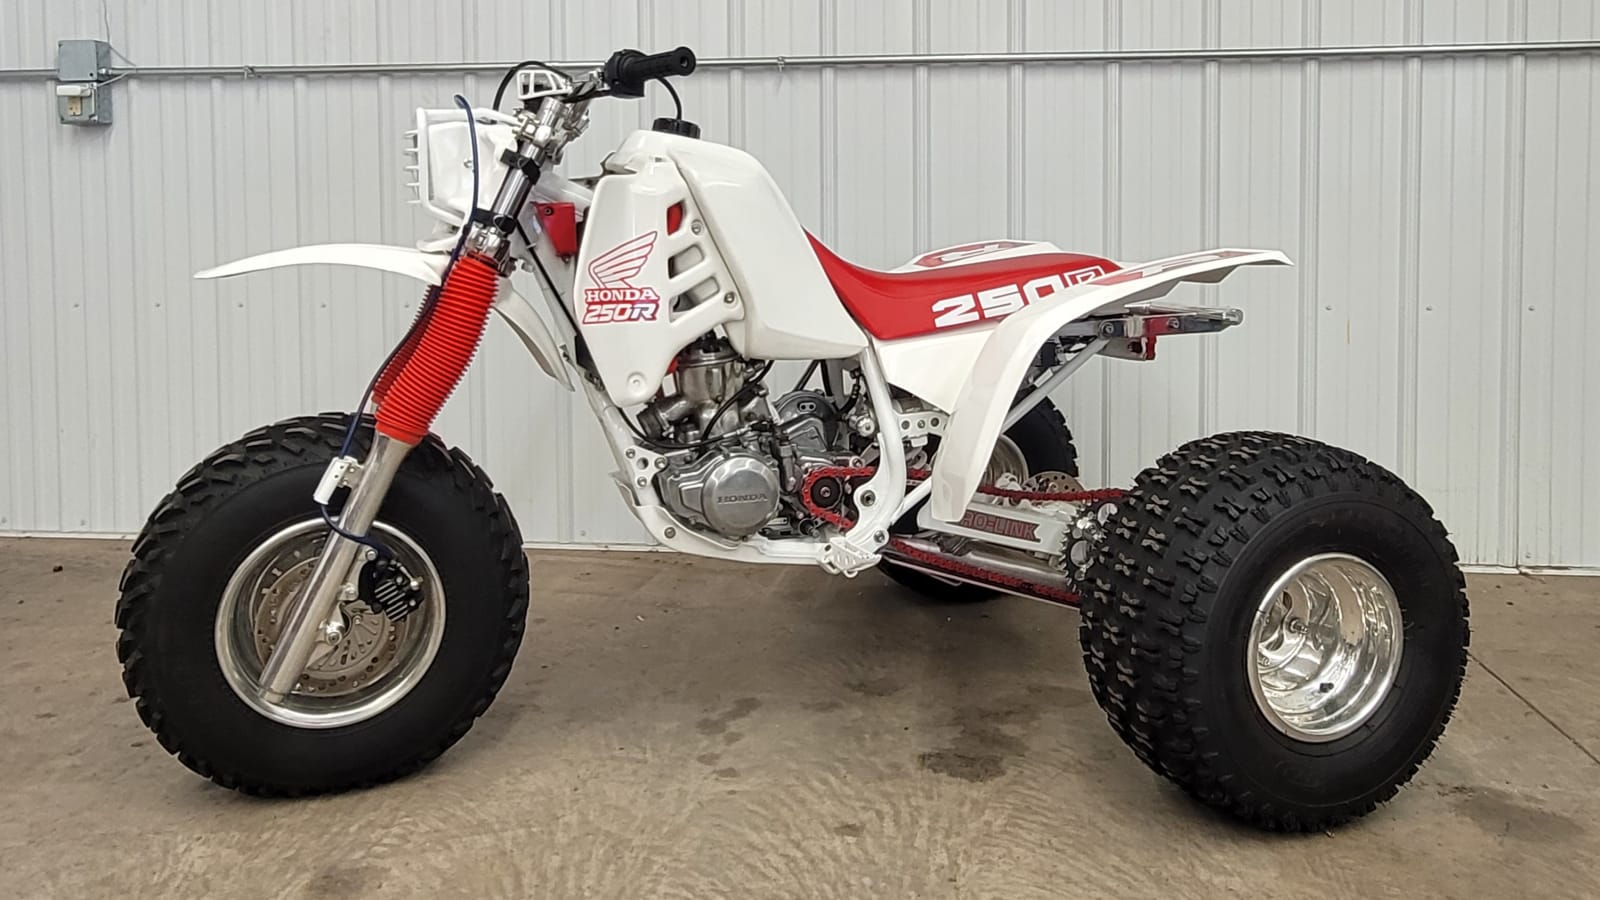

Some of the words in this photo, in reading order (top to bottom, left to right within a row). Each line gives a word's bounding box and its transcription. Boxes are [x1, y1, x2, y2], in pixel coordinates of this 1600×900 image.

[585, 288, 659, 303] HONDA
[583, 302, 659, 324] 250R
[717, 494, 768, 504] HONDA
[960, 510, 1036, 540] RO-LINK
